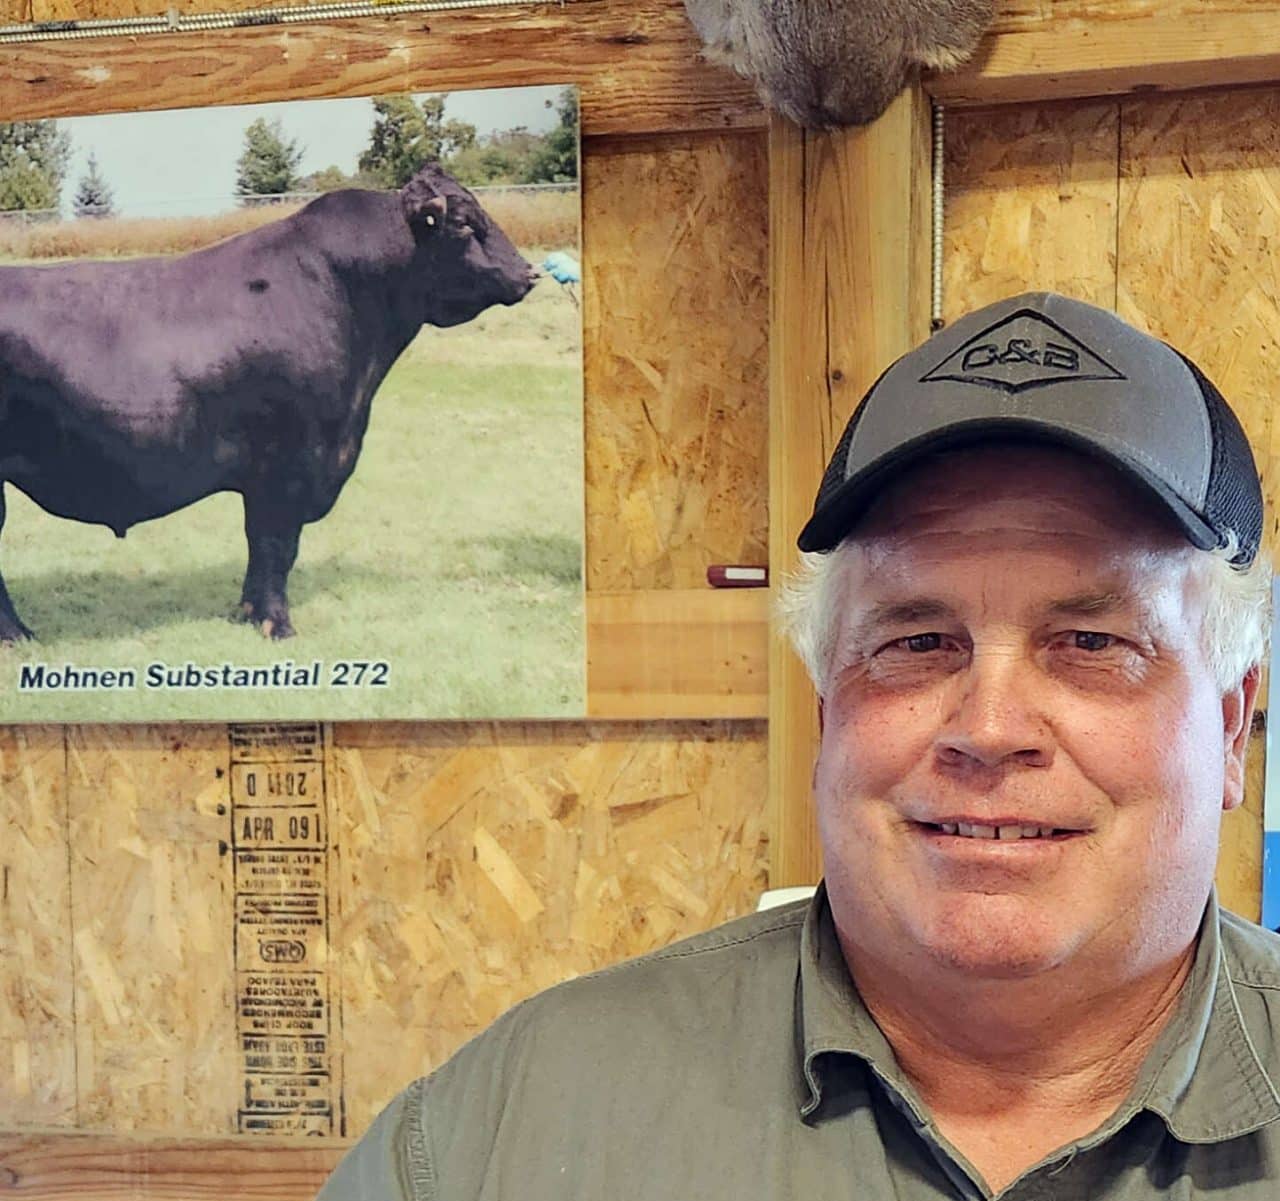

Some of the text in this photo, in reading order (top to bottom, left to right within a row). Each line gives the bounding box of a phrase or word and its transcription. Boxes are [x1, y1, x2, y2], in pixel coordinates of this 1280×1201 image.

[20, 662, 390, 689] Mohnen Substantial 272
[243, 816, 310, 841] APR 09
[264, 942, 301, 959] QMS
